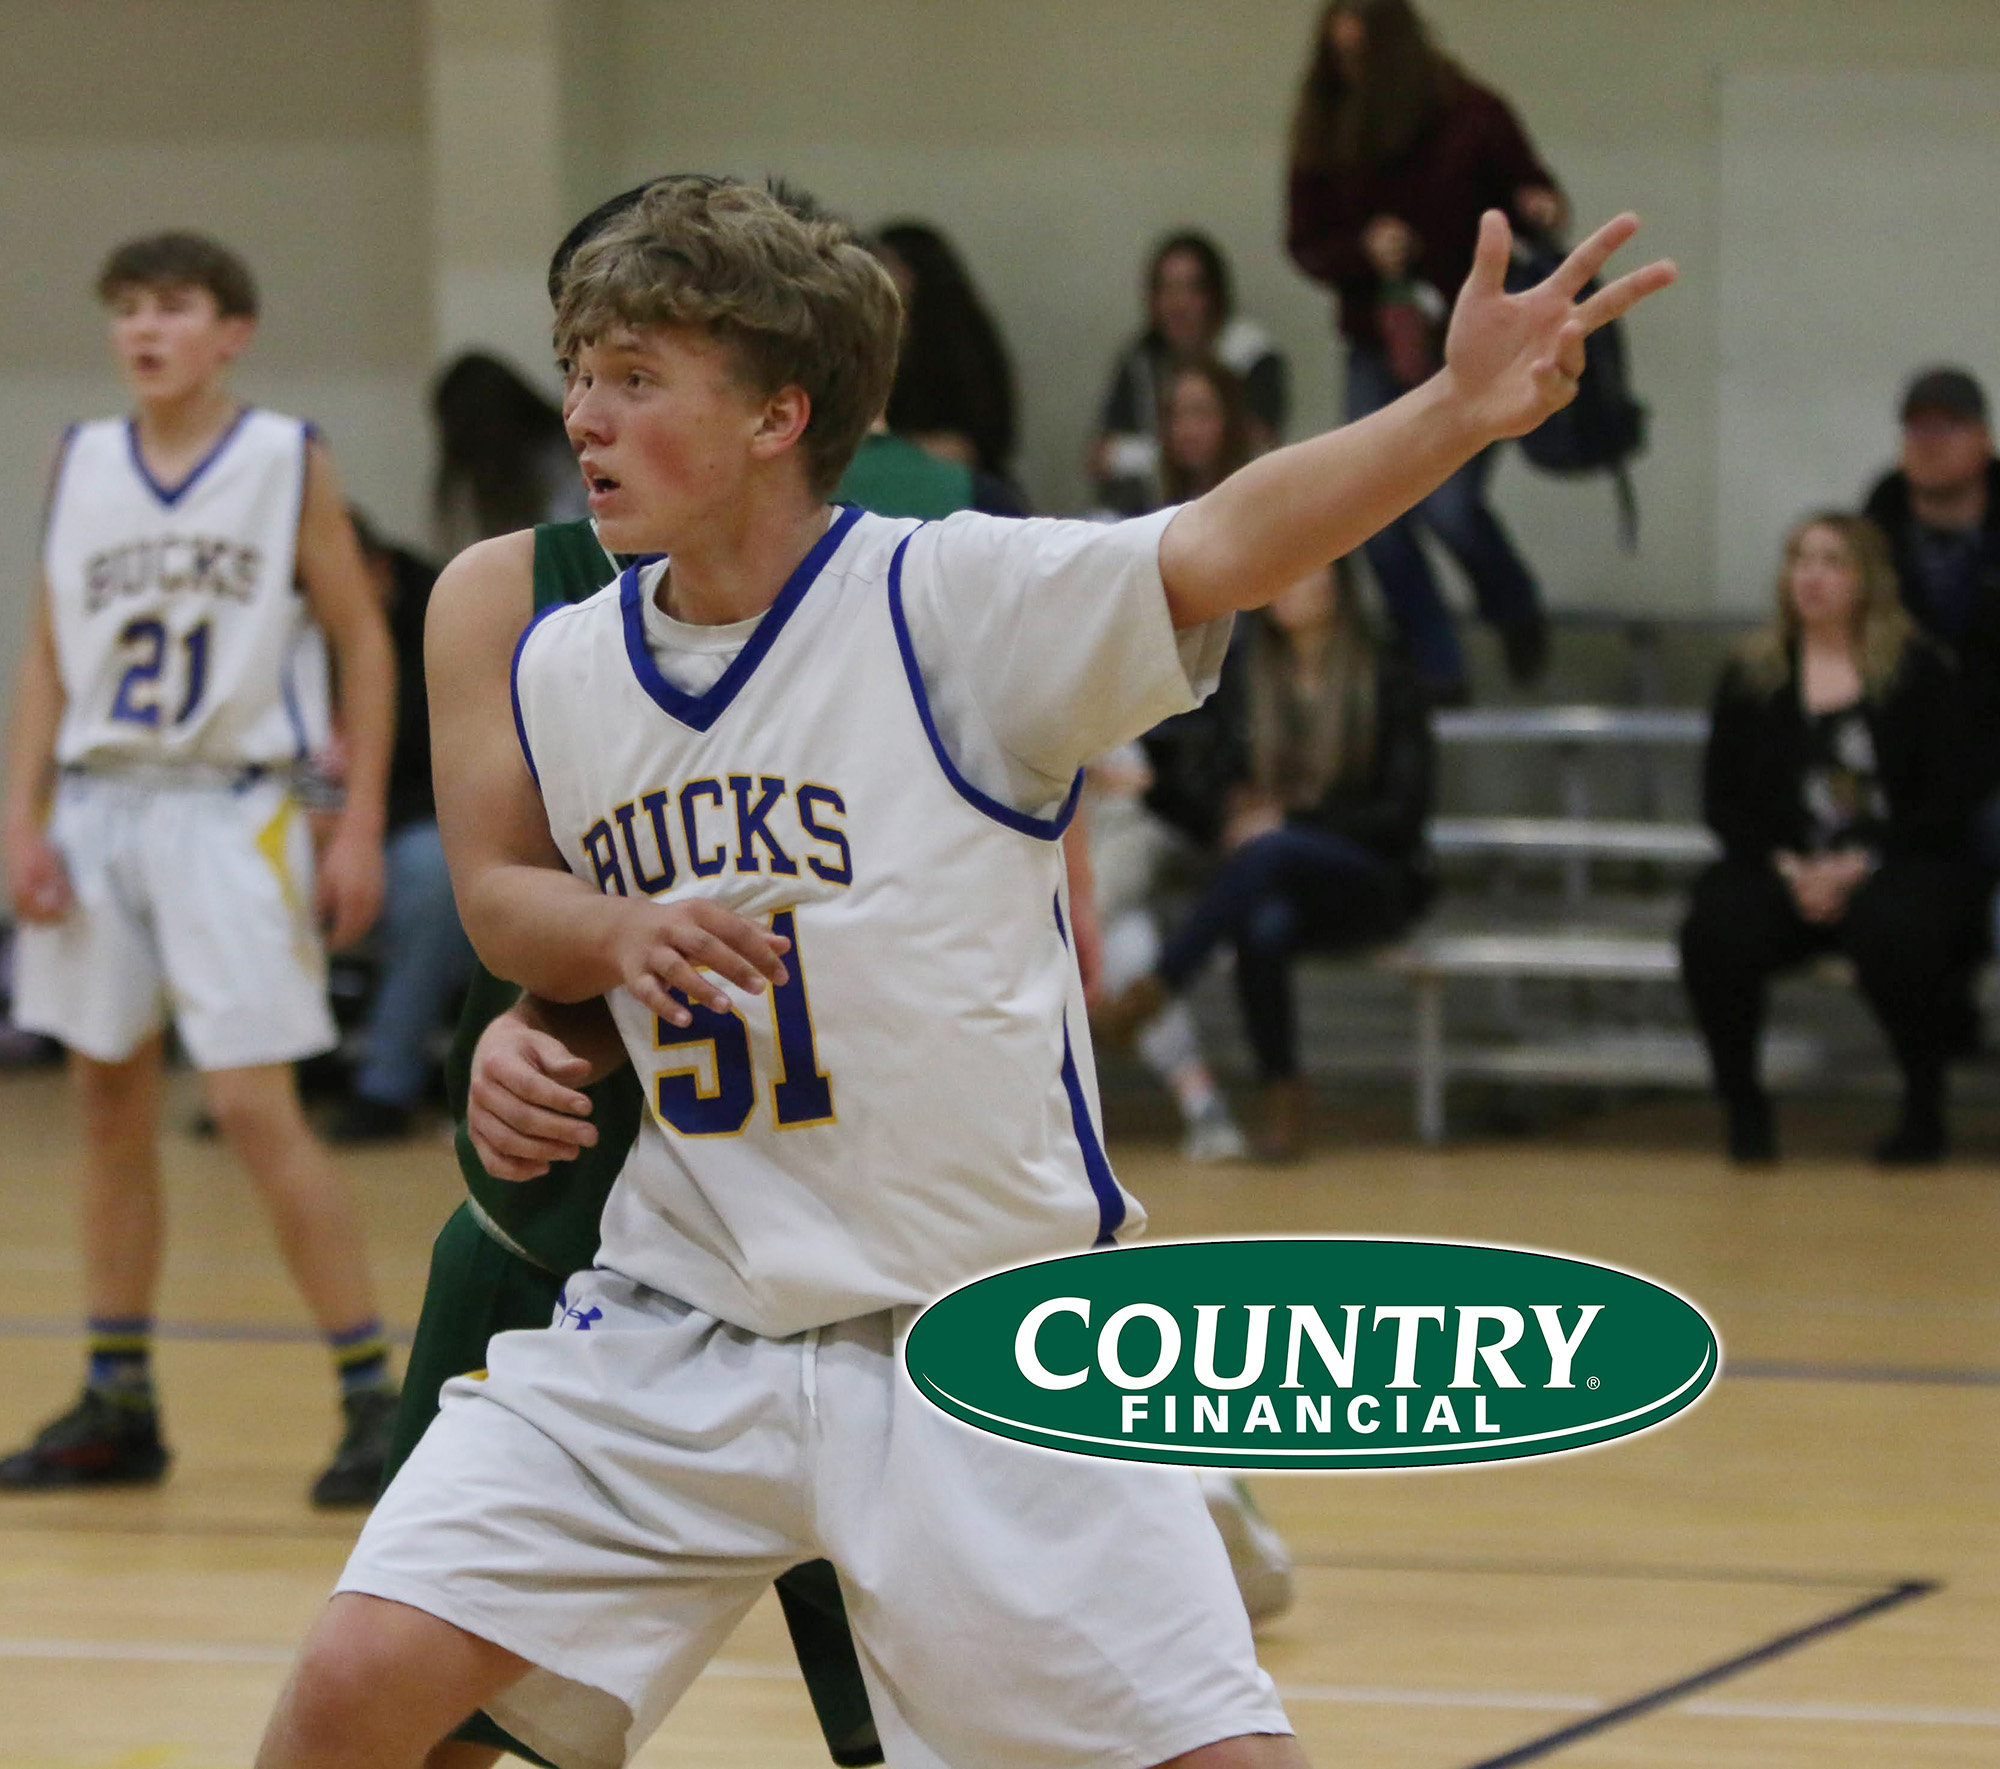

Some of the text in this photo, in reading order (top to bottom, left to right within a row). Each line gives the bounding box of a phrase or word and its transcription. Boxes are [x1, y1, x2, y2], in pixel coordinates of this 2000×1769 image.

[109, 612, 213, 725] 21
[581, 773, 853, 897] BUCKS
[652, 905, 838, 1138] 51
